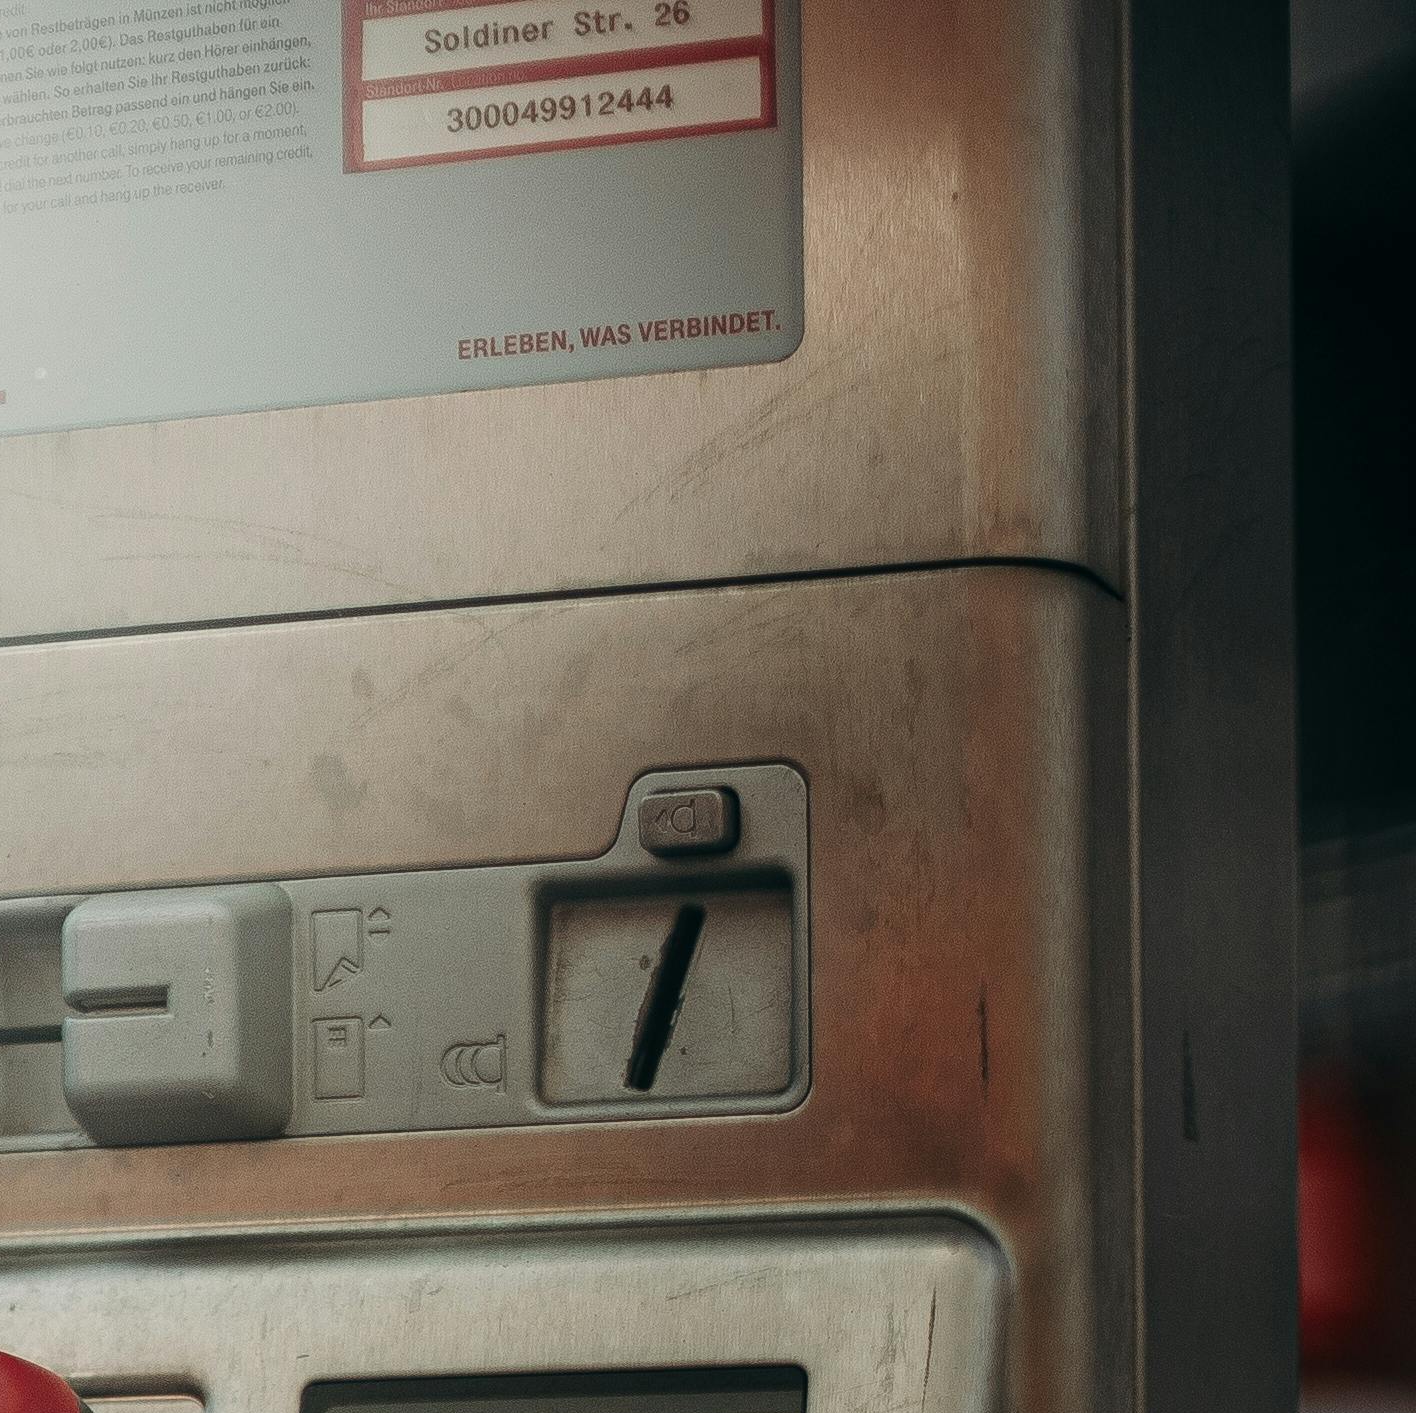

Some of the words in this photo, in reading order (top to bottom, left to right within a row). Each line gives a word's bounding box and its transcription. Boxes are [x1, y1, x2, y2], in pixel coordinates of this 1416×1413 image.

[6, 26, 27, 38] von
[31, 14, 114, 34] Restbeträgen
[119, 10, 129, 23] in
[134, 6, 183, 21] Münzen
[187, 0, 201, 14] ist
[205, 0, 235, 12] nicht
[38, 42, 67, 56] oder
[119, 33, 143, 46] Das
[147, 22, 235, 43] Restguthaben
[239, 18, 256, 32] für
[260, 15, 279, 29] ein
[425, 19, 553, 54] Soldiner
[574, 10, 633, 36] Str.
[655, 2, 691, 27] 26
[25, 65, 44, 79] Sie
[47, 62, 67, 76] wie
[71, 58, 99, 75] folgt
[100, 55, 145, 70] nutzen:
[148, 51, 174, 64] kurz
[178, 47, 200, 61] den
[204, 43, 238, 57] Hörer
[54, 84, 69, 98] So
[73, 79, 124, 95] erhalten
[127, 75, 147, 89] Sie
[151, 72, 167, 86] Ihr
[171, 63, 259, 84] Restguthaben
[263, 55, 310, 73] zurück:
[71, 103, 111, 118] Betrag
[115, 94, 167, 116] passend
[170, 92, 189, 106] ein
[192, 88, 215, 103] und
[219, 85, 265, 100] hängen
[269, 80, 288, 94] Sie
[447, 84, 674, 134] 300049912444
[14, 132, 57, 146] change
[239, 109, 251, 120] or
[33, 153, 47, 167] for
[51, 148, 96, 164] another
[127, 140, 167, 156] simply
[170, 138, 200, 151] hang
[203, 136, 219, 149] up
[223, 132, 238, 145] for
[242, 133, 249, 143] a
[27, 175, 45, 189] the
[47, 171, 72, 186] next
[126, 164, 139, 178] To
[142, 160, 183, 176] receive
[185, 159, 211, 174] your
[214, 150, 273, 168] remaining
[21, 199, 47, 214] your
[50, 193, 70, 208] call
[74, 190, 97, 205] and
[100, 189, 130, 203] hang
[134, 187, 150, 200] up
[153, 182, 172, 196] the
[458, 329, 574, 360] ERLEBEN,
[580, 324, 632, 349] WAS
[638, 310, 781, 342] VERBINDET.
